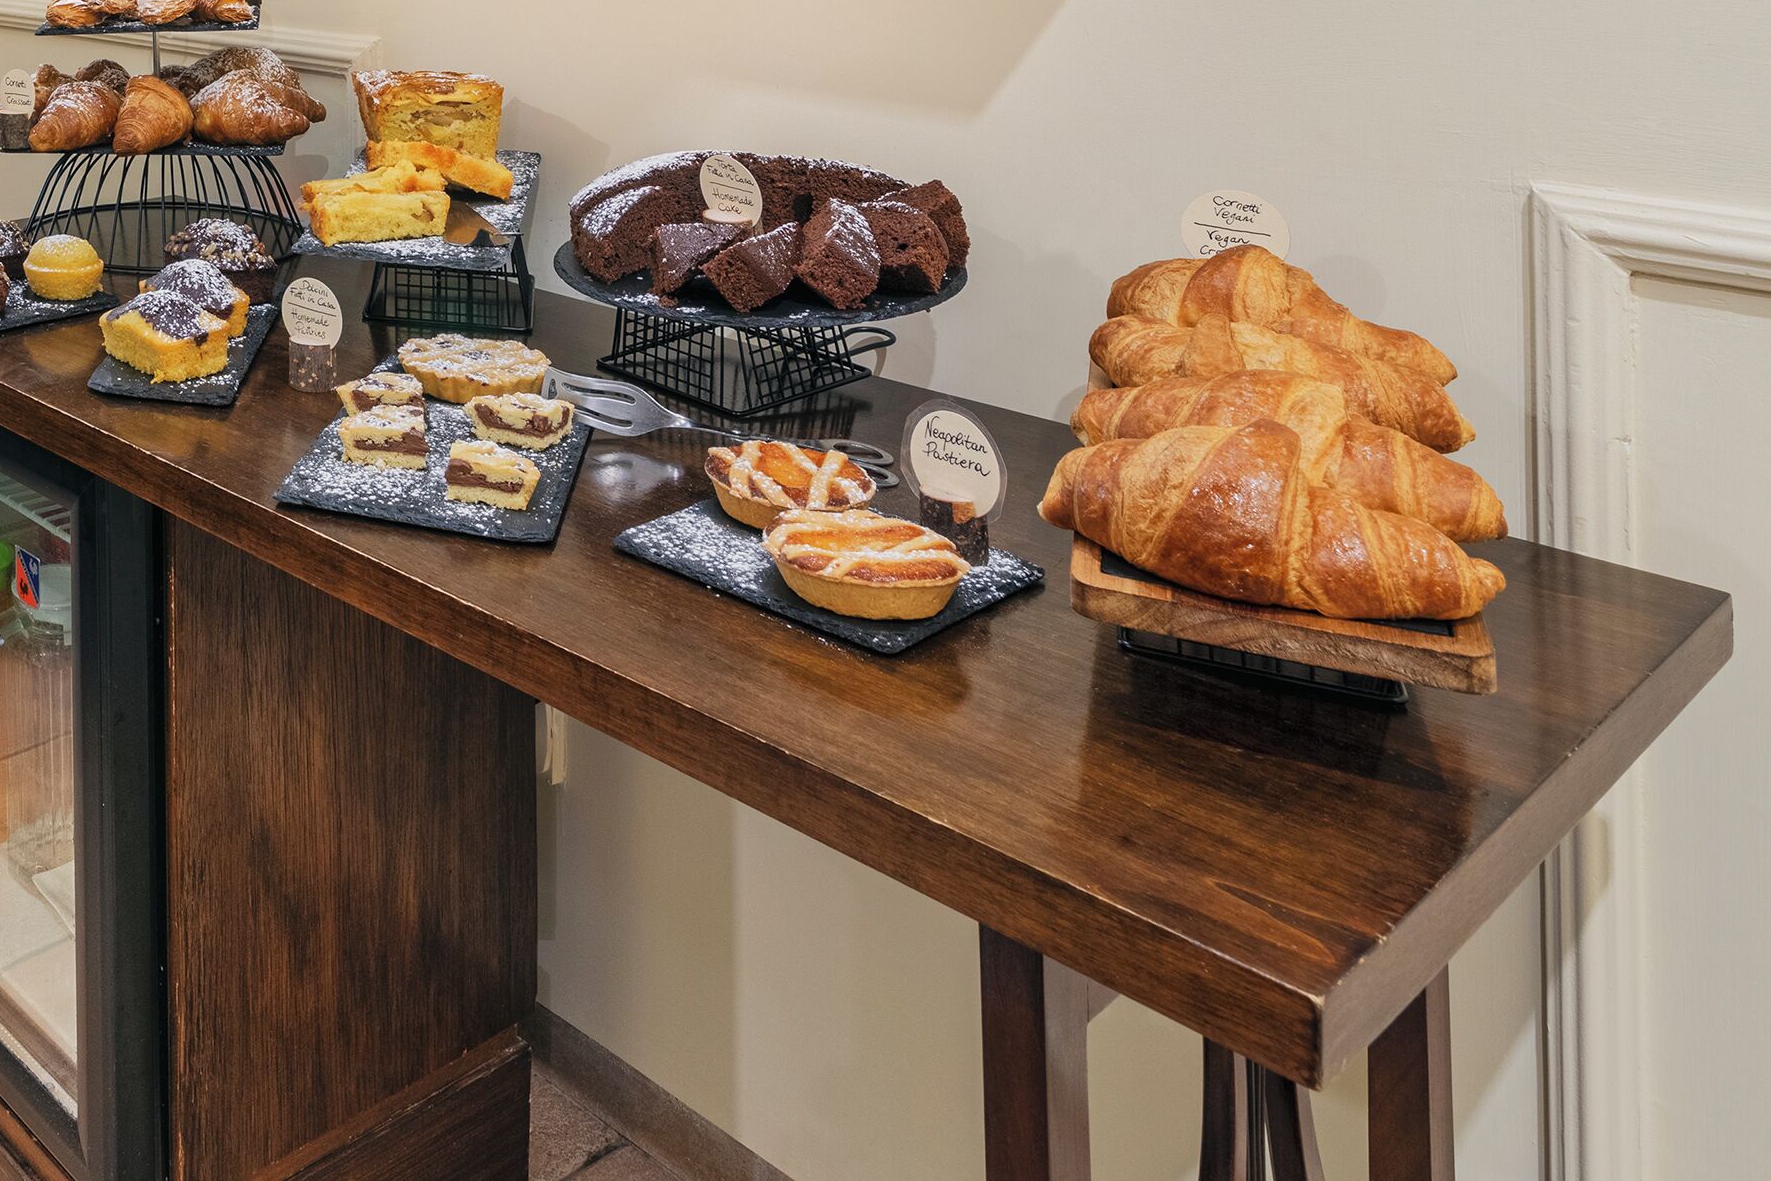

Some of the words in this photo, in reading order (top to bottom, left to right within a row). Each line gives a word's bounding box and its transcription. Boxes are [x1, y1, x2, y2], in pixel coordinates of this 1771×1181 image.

[714, 159, 738, 173] Torta
[735, 174, 754, 187] Casa
[712, 188, 754, 207] Homemade
[1213, 196, 1263, 214] Cornetti
[718, 203, 742, 215] Cake
[1214, 207, 1256, 225] Vegani
[1207, 230, 1250, 248] Vegan
[299, 280, 329, 297] Dolcini
[317, 298, 336, 310] Casa
[291, 308, 330, 327] Homemade
[295, 321, 326, 339] Pastries
[925, 416, 988, 454] Neapolitan
[922, 441, 991, 477] Pastiera
